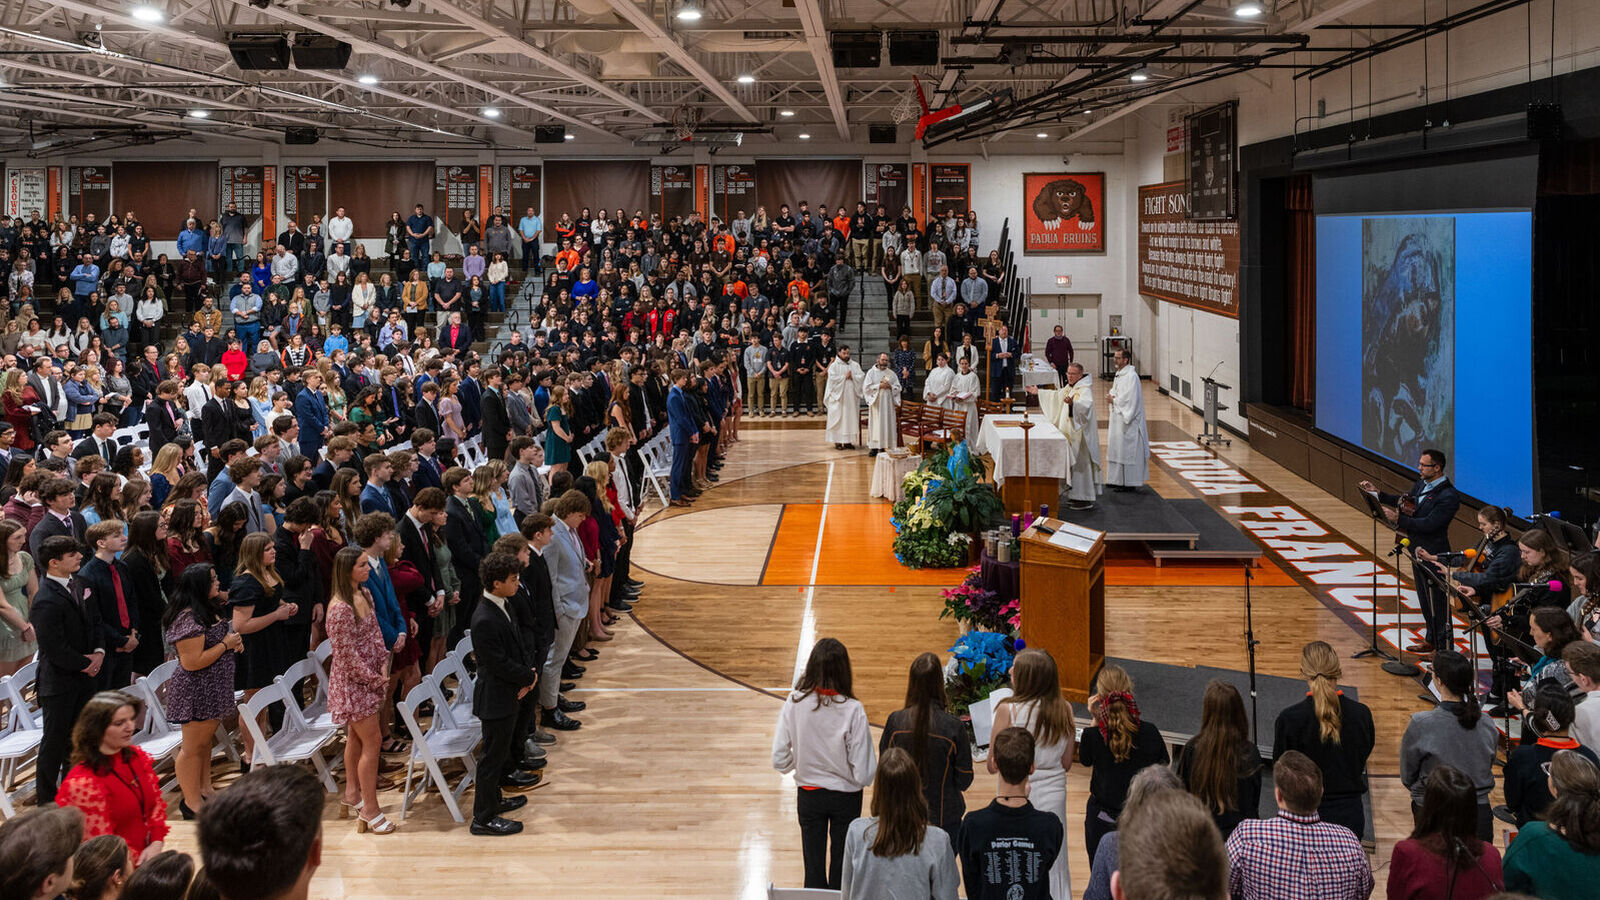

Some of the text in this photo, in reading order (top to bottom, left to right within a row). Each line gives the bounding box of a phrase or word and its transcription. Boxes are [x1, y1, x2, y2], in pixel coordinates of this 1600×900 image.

[1145, 196, 1166, 215] FIGHT
[1031, 233, 1097, 244] PADUA BRUINS
[1149, 440, 1268, 496] PADUA
[991, 840, 1035, 849] Parlor Games
